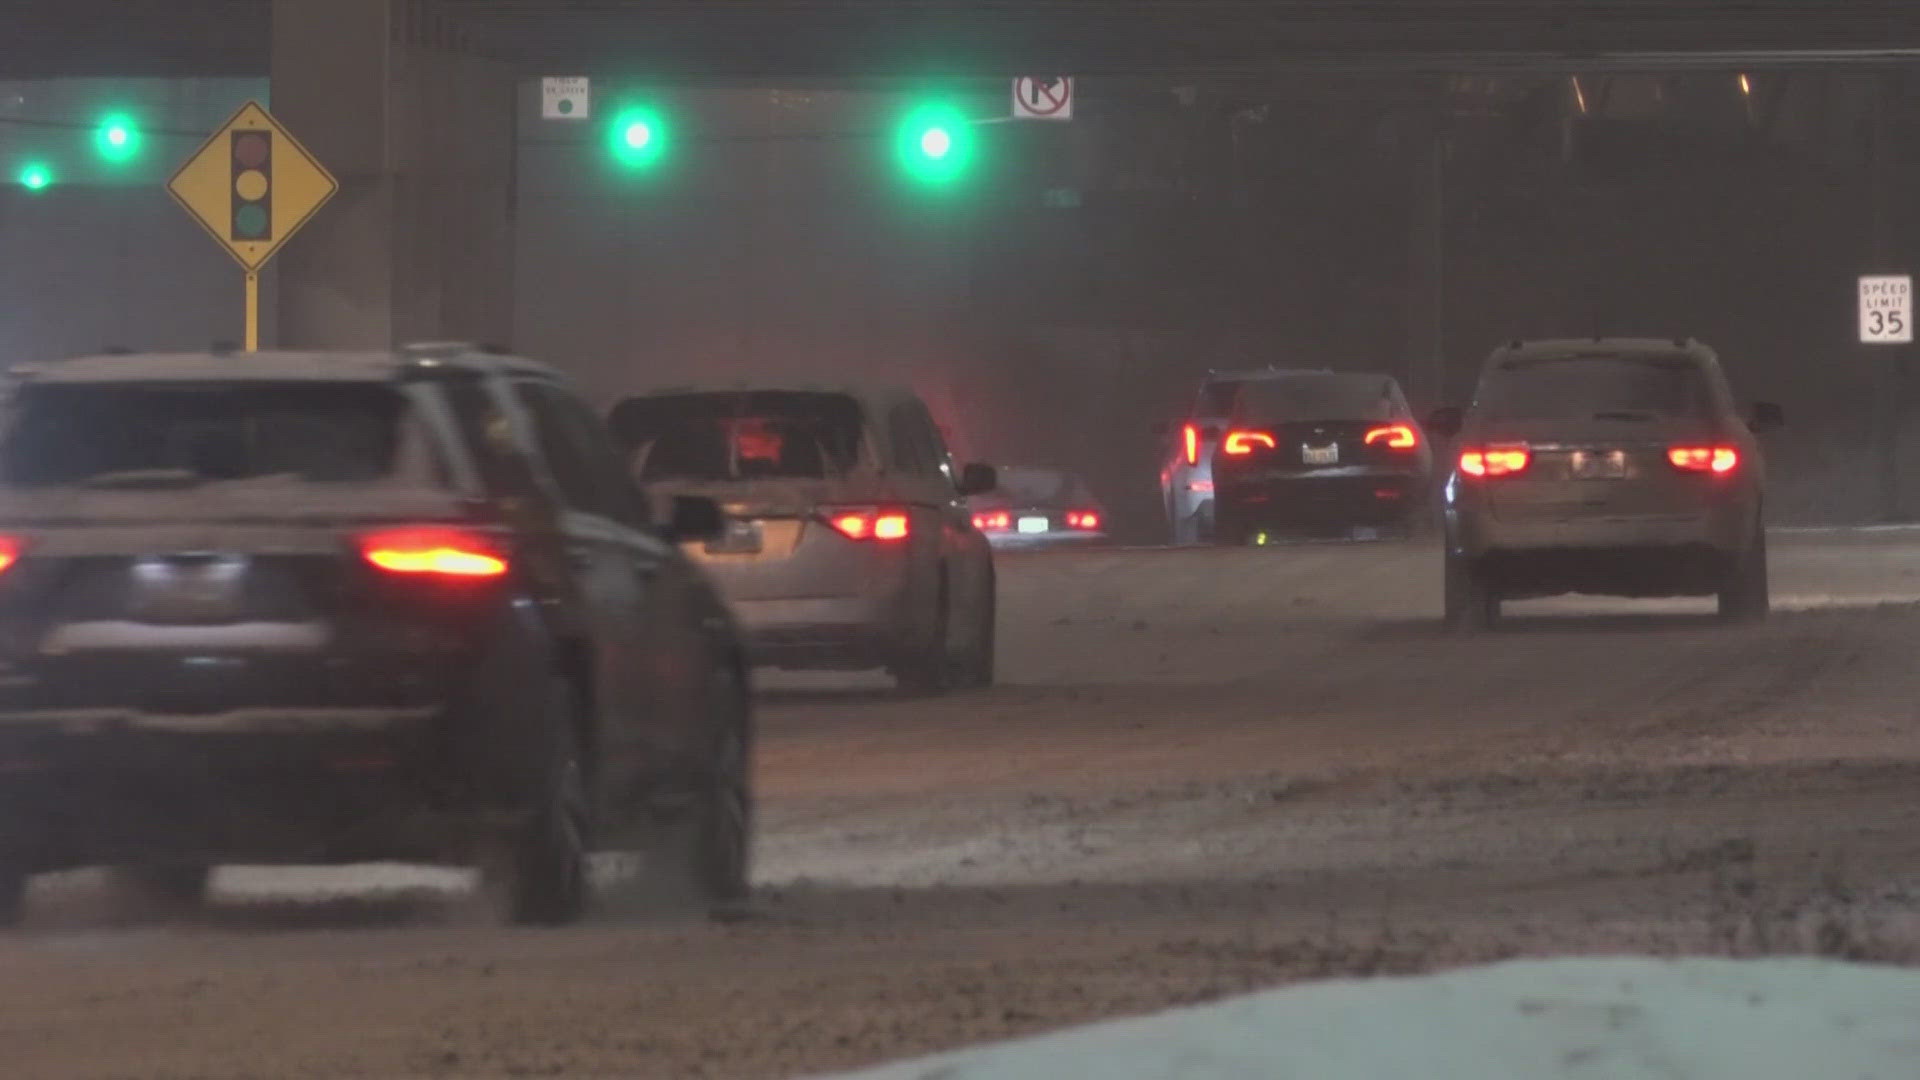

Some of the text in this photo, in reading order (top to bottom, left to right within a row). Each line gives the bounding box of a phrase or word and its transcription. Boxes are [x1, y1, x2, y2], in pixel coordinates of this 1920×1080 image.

[1863, 283, 1907, 295] SPEED
[1866, 297, 1903, 308] LIMIT
[1869, 310, 1903, 335] 35
